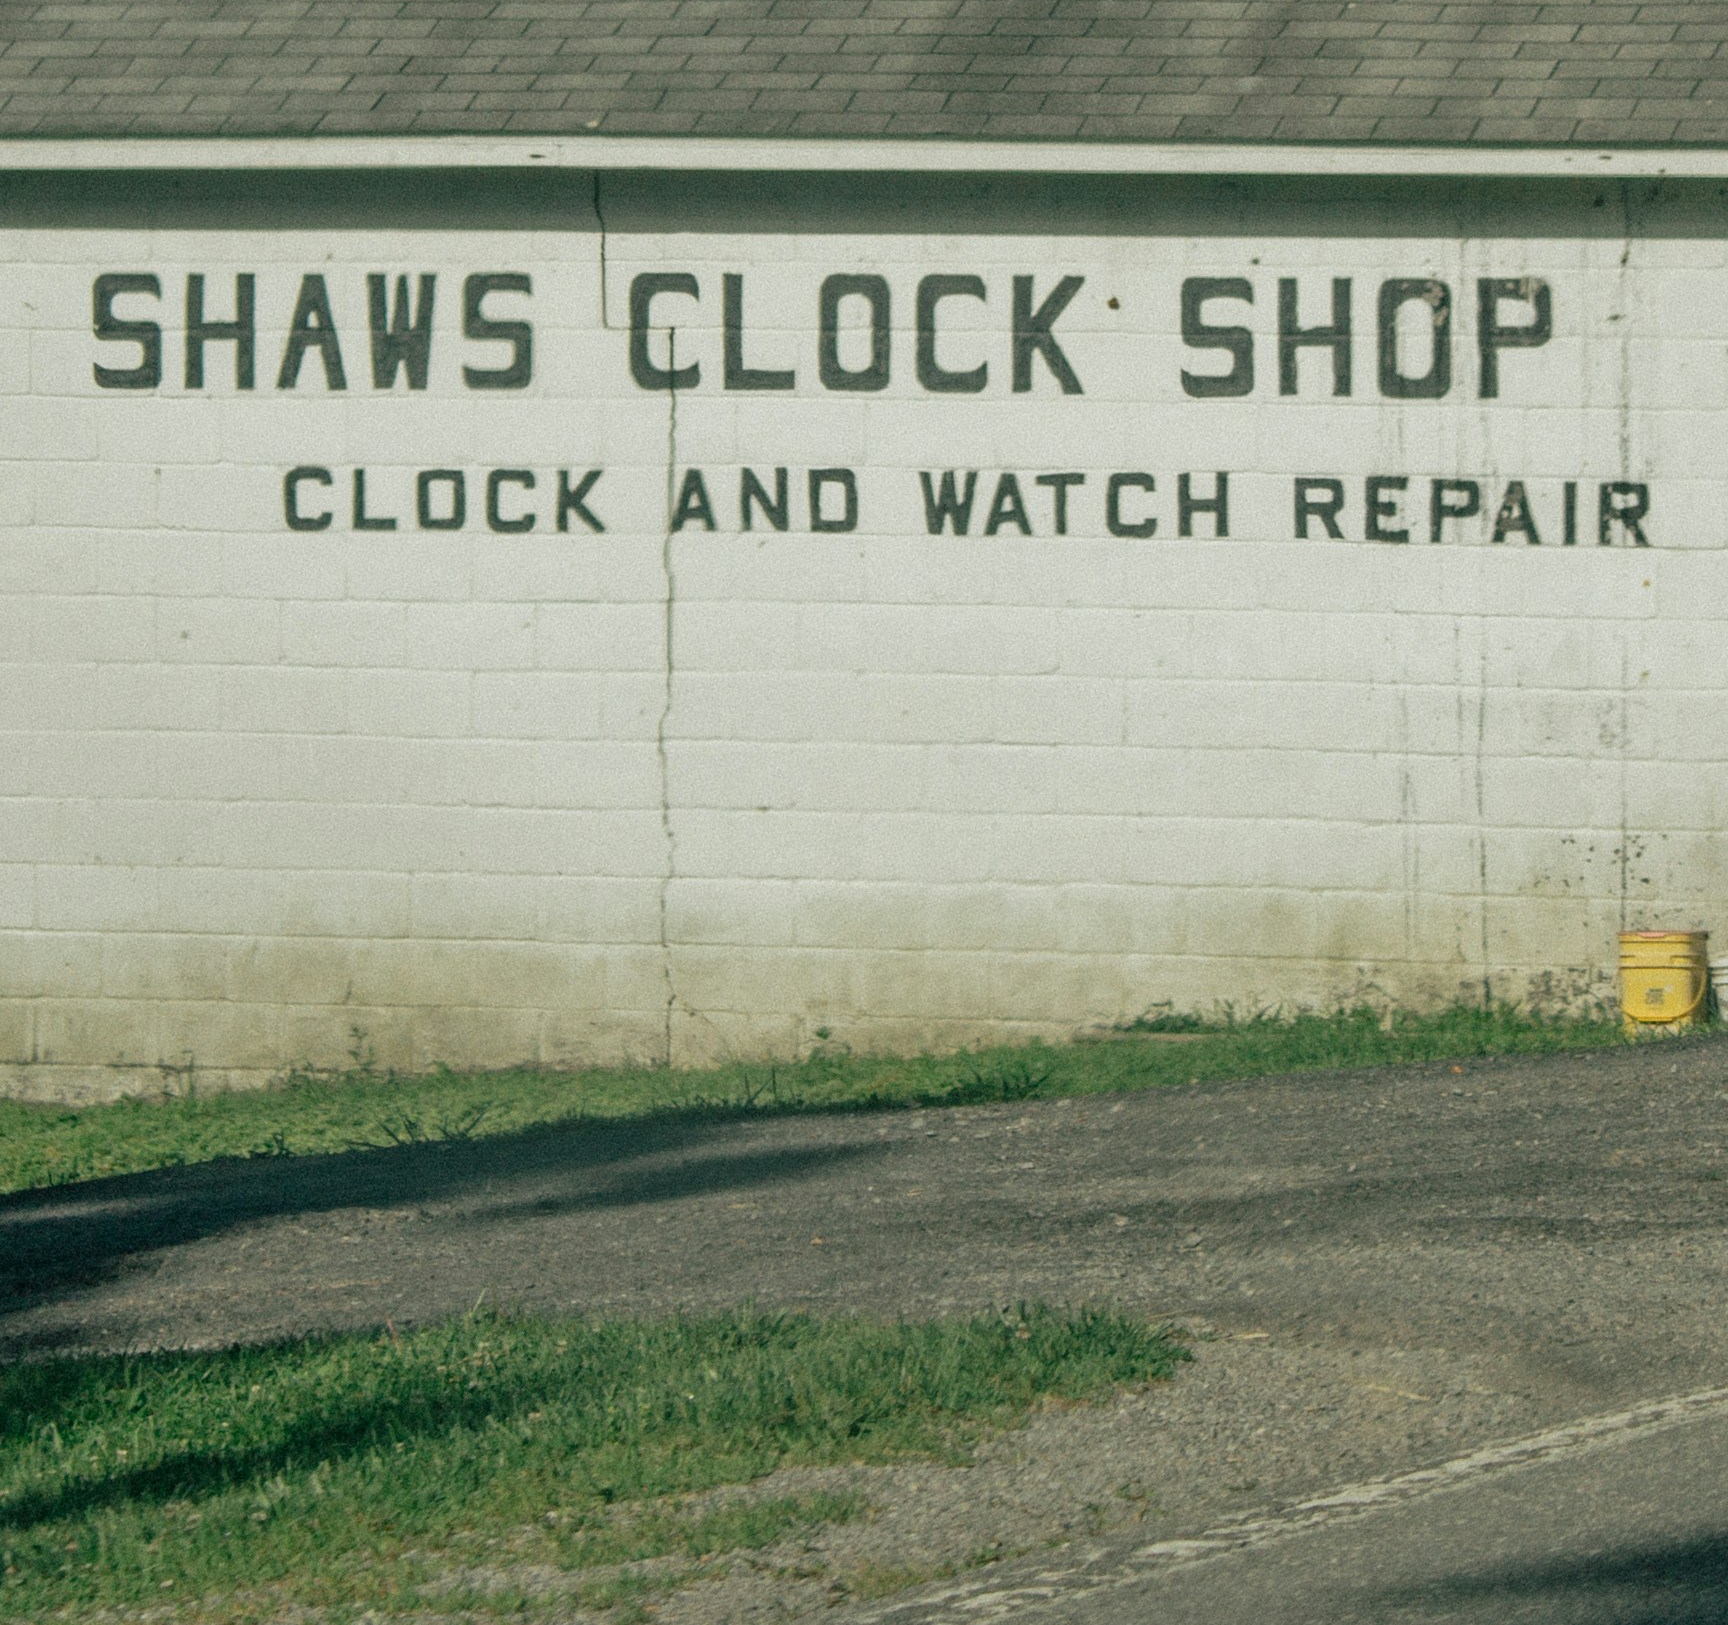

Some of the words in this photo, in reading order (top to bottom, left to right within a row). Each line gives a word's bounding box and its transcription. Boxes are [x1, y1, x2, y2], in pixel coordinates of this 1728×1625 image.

[91, 271, 534, 391] SHAWS
[628, 272, 1086, 395] CLOCK
[1179, 276, 1553, 399] SHOP
[283, 465, 606, 534] CLOCK
[668, 467, 859, 535] AND
[918, 469, 1230, 539] WATCH
[1293, 475, 1651, 549] REPAIR
